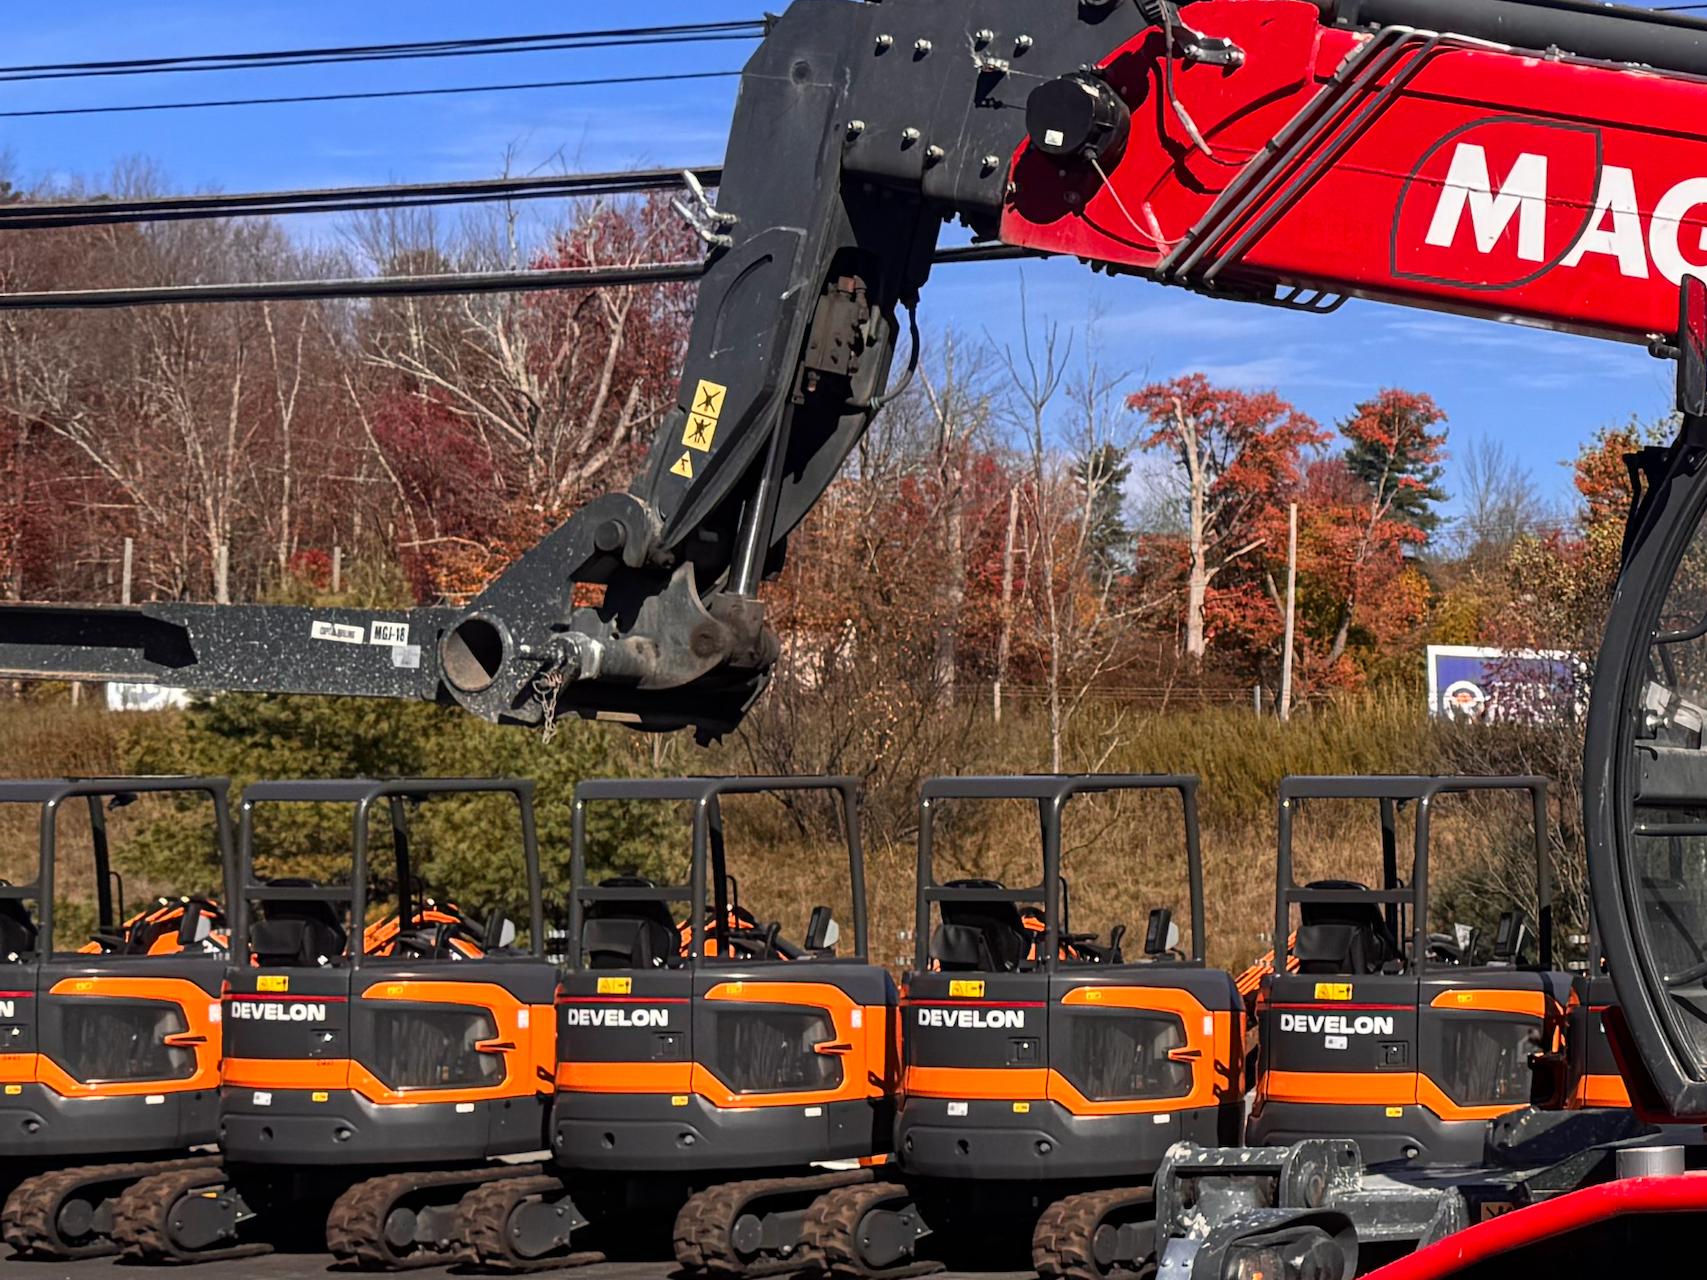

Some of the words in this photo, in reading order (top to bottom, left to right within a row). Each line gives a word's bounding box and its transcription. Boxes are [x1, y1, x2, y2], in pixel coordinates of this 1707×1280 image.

[231, 1001, 326, 1022] DEVELON
[568, 1007, 669, 1027] DEVELON
[917, 1008, 1025, 1029] DEVELON
[1280, 1013, 1394, 1036] DEVELON
